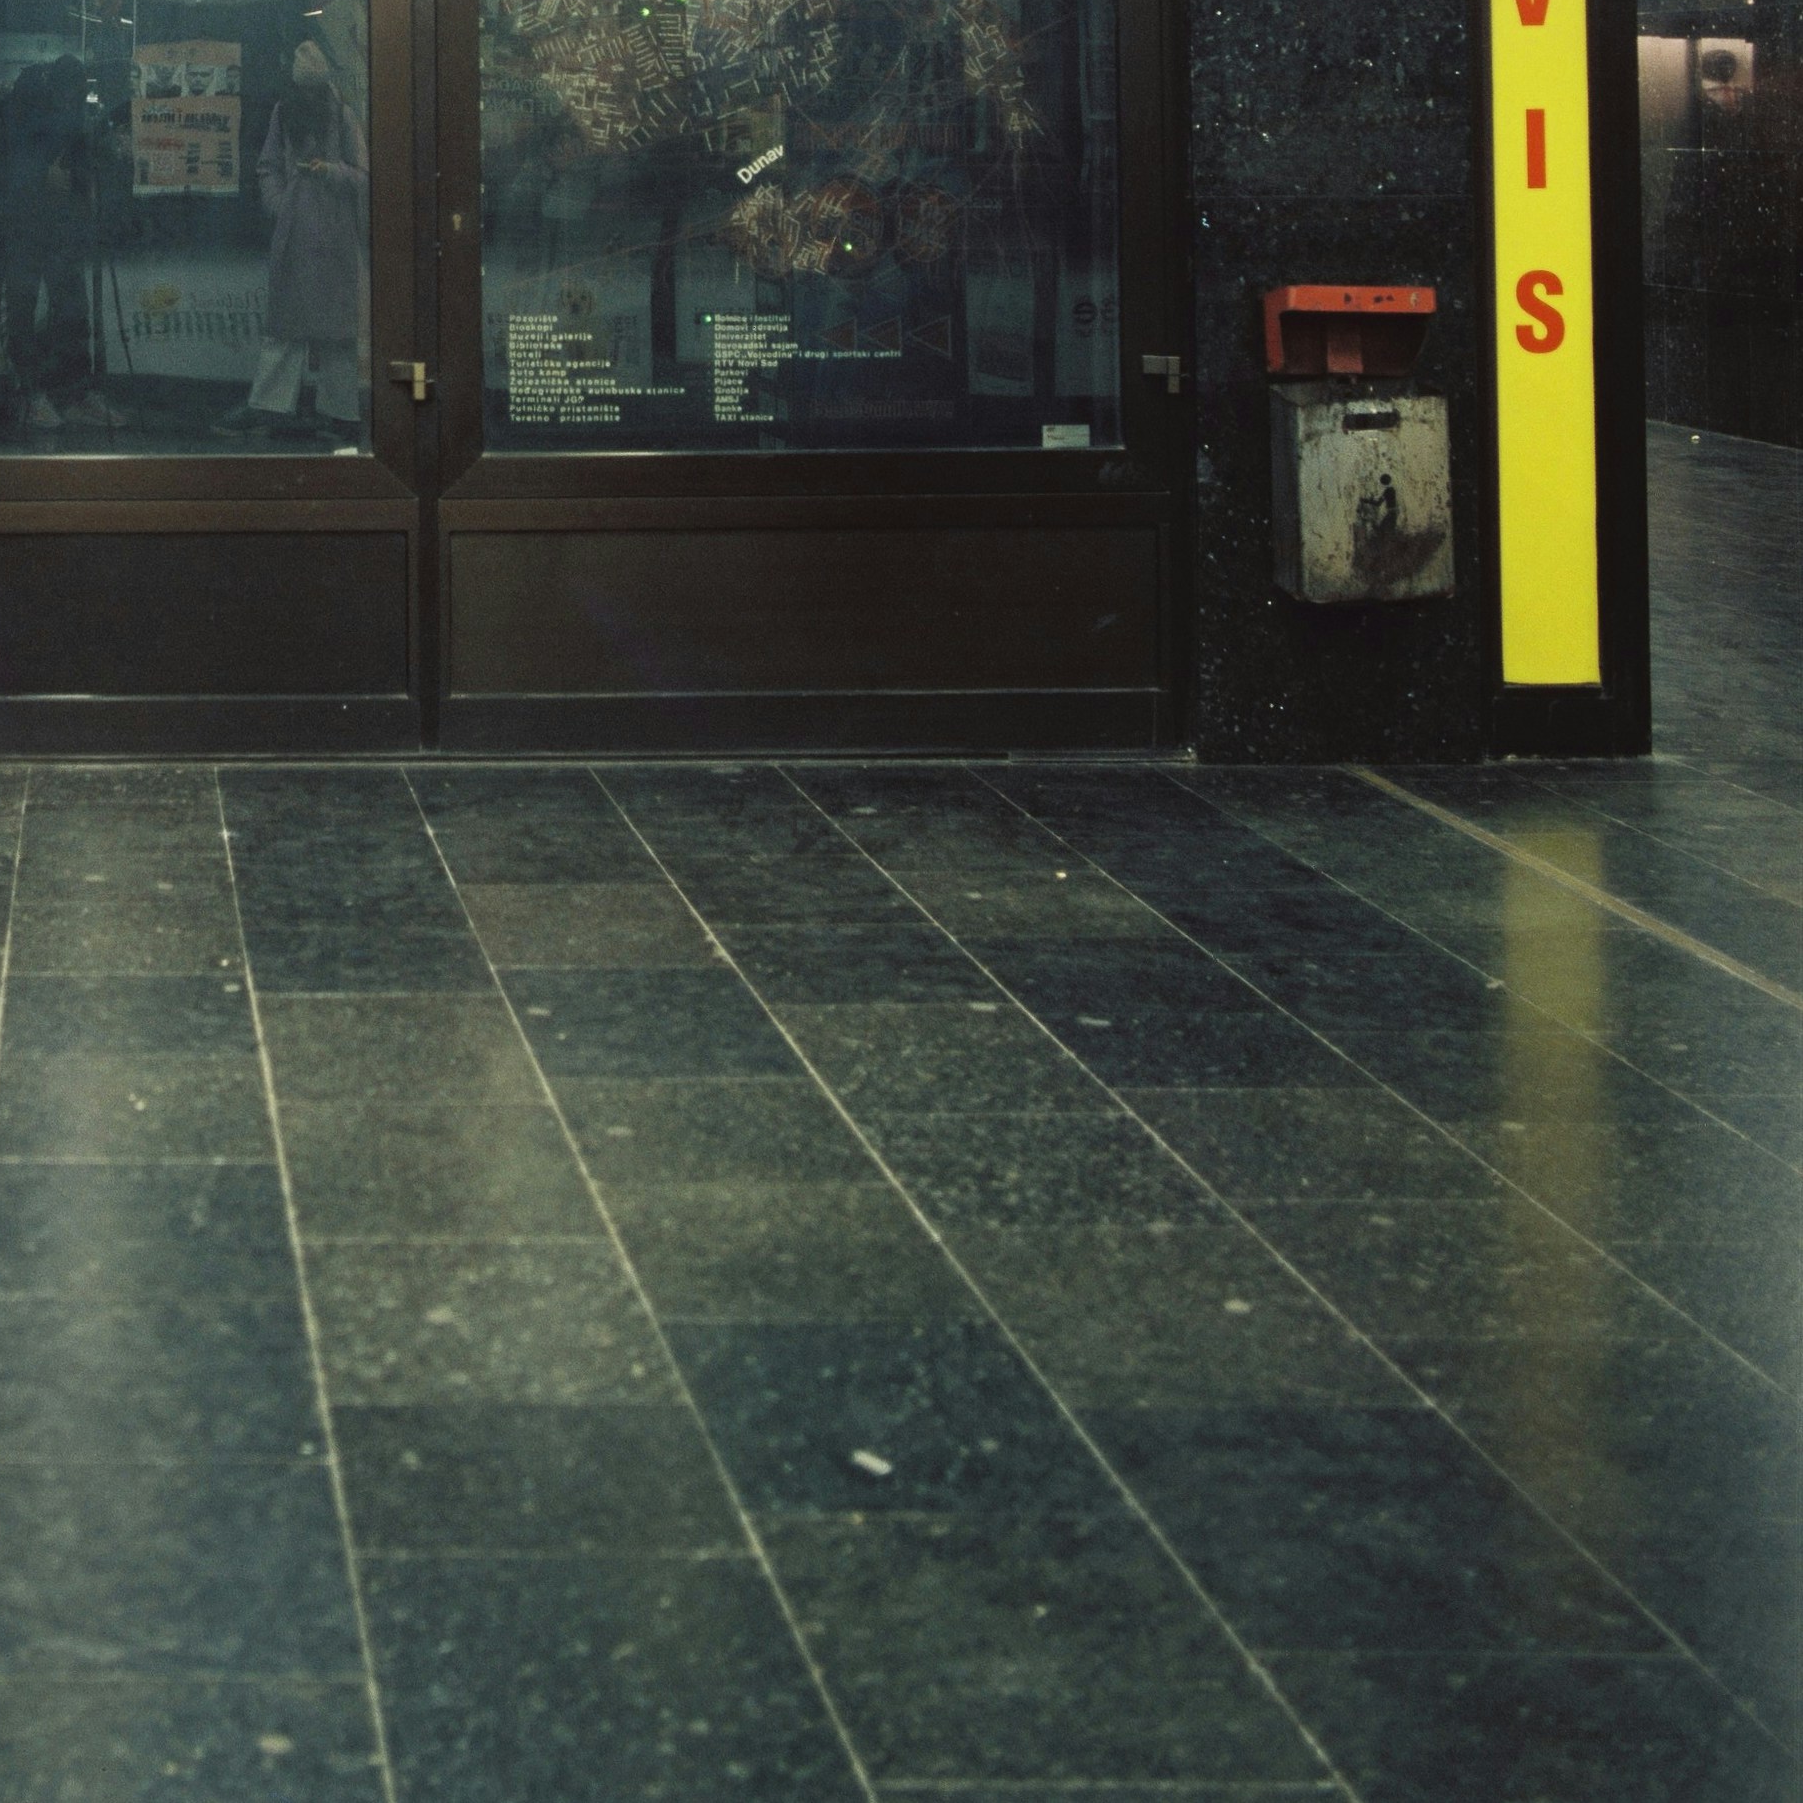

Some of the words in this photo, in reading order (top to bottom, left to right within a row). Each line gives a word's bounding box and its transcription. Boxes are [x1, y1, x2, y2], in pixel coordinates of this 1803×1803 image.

[736, 143, 785, 186] Dunav
[713, 358, 735, 368] RTV
[760, 358, 779, 368] Sad
[714, 412, 737, 422] TAXI
